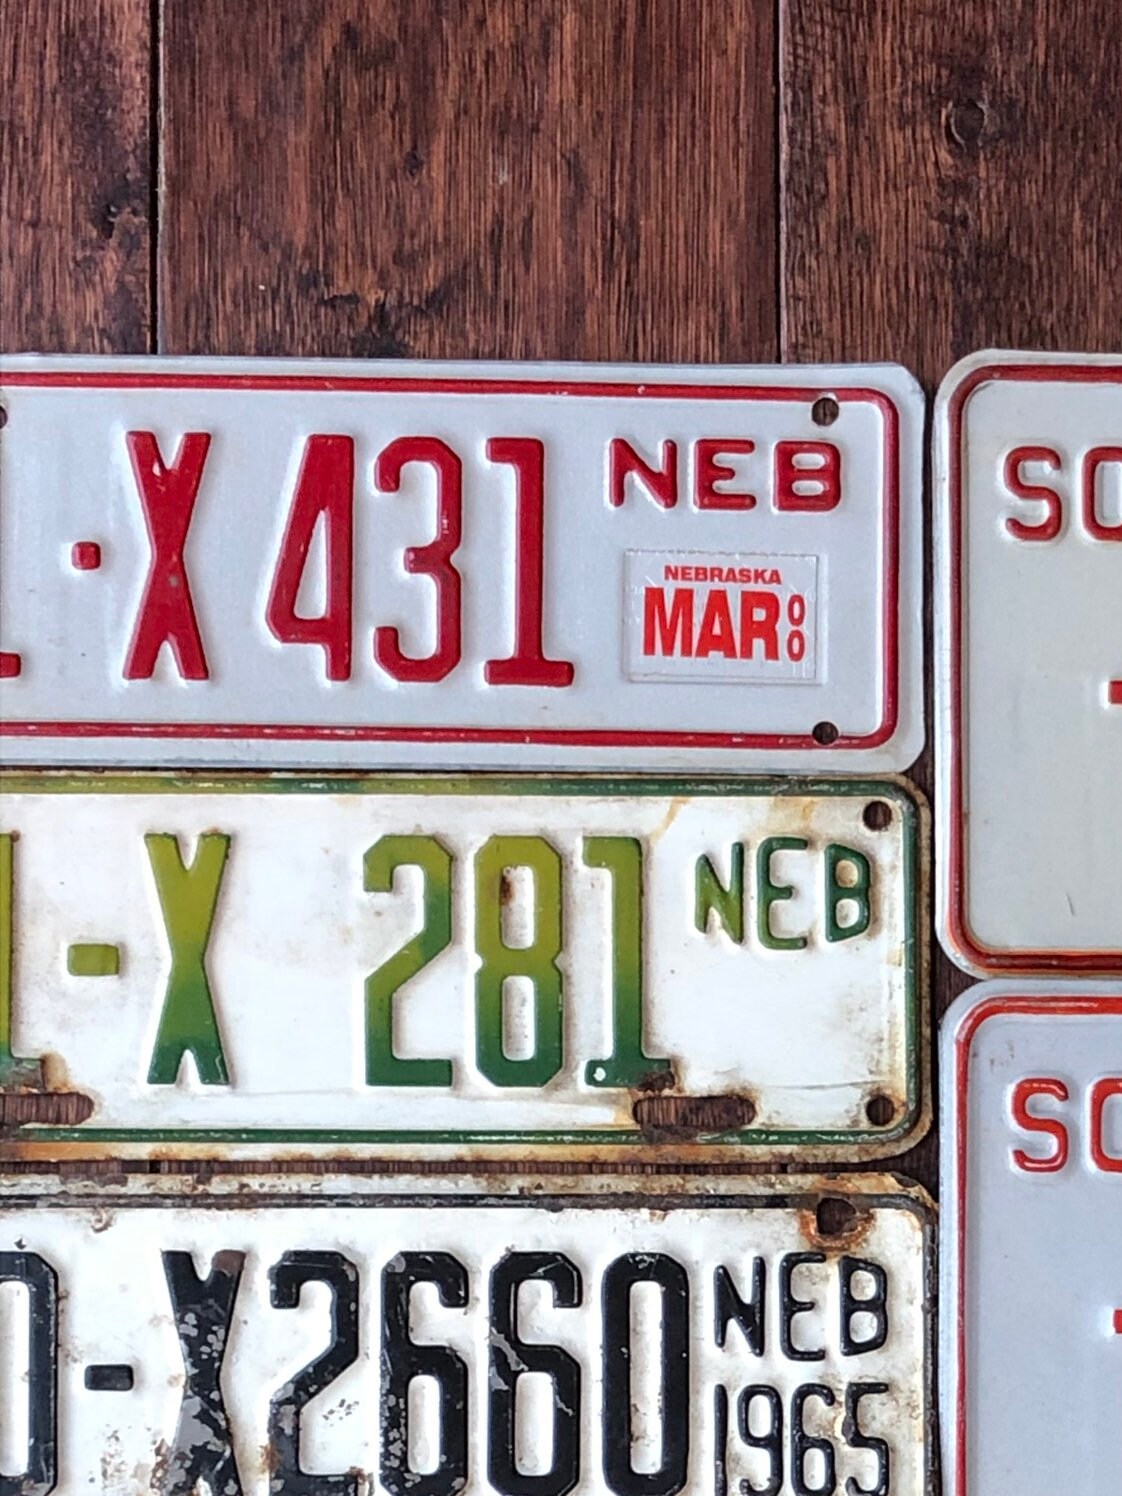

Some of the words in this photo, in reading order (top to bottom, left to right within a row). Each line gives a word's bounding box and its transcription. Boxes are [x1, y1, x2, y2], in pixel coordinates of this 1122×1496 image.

[608, 437, 843, 512] NEB
[664, 564, 783, 586] NEBRASKA
[642, 586, 781, 661] MAR
[695, 836, 873, 949] NEB
[363, 833, 676, 1087] 281
[713, 1252, 889, 1362] NEB
